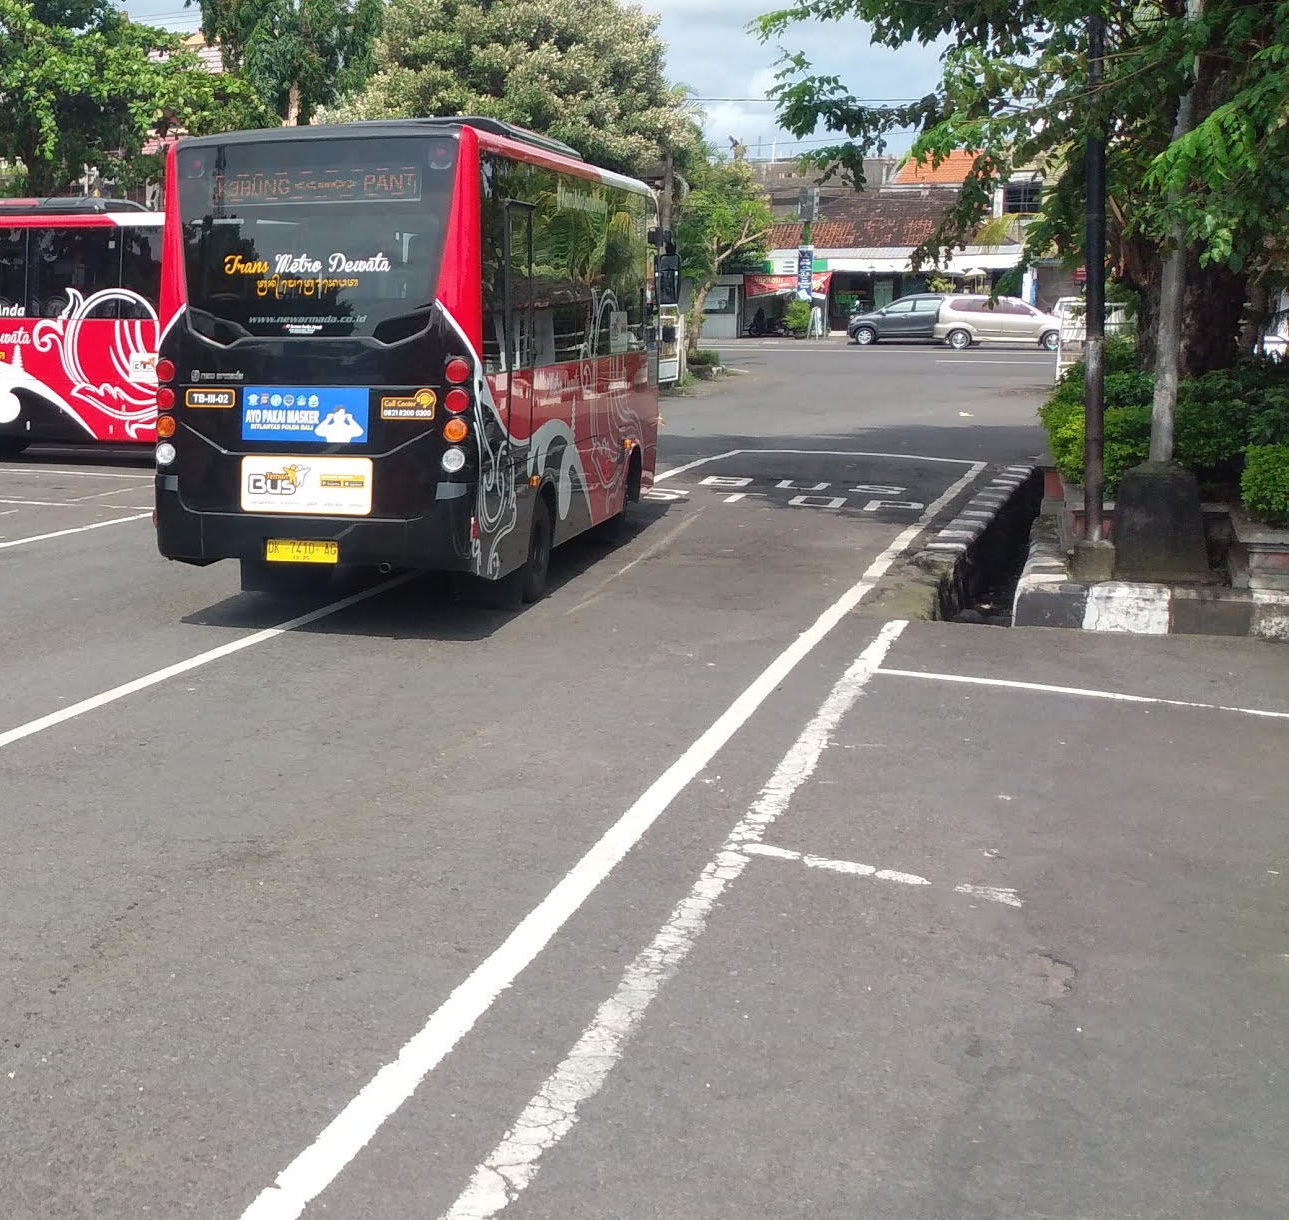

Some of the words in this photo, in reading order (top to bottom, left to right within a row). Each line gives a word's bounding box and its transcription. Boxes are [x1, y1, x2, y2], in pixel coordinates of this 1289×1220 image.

[224, 254, 269, 276] Trans
[274, 252, 323, 274] Metro
[328, 251, 392, 274] Dewata
[248, 314, 368, 325] www.newarmada.co.id
[192, 393, 229, 404] TB-III-02
[245, 409, 261, 424] AYO
[262, 409, 286, 424] PAKAI
[287, 409, 320, 425] MASKER
[268, 541, 280, 554] DK
[289, 541, 315, 555] 7410
[324, 543, 337, 556] AG
